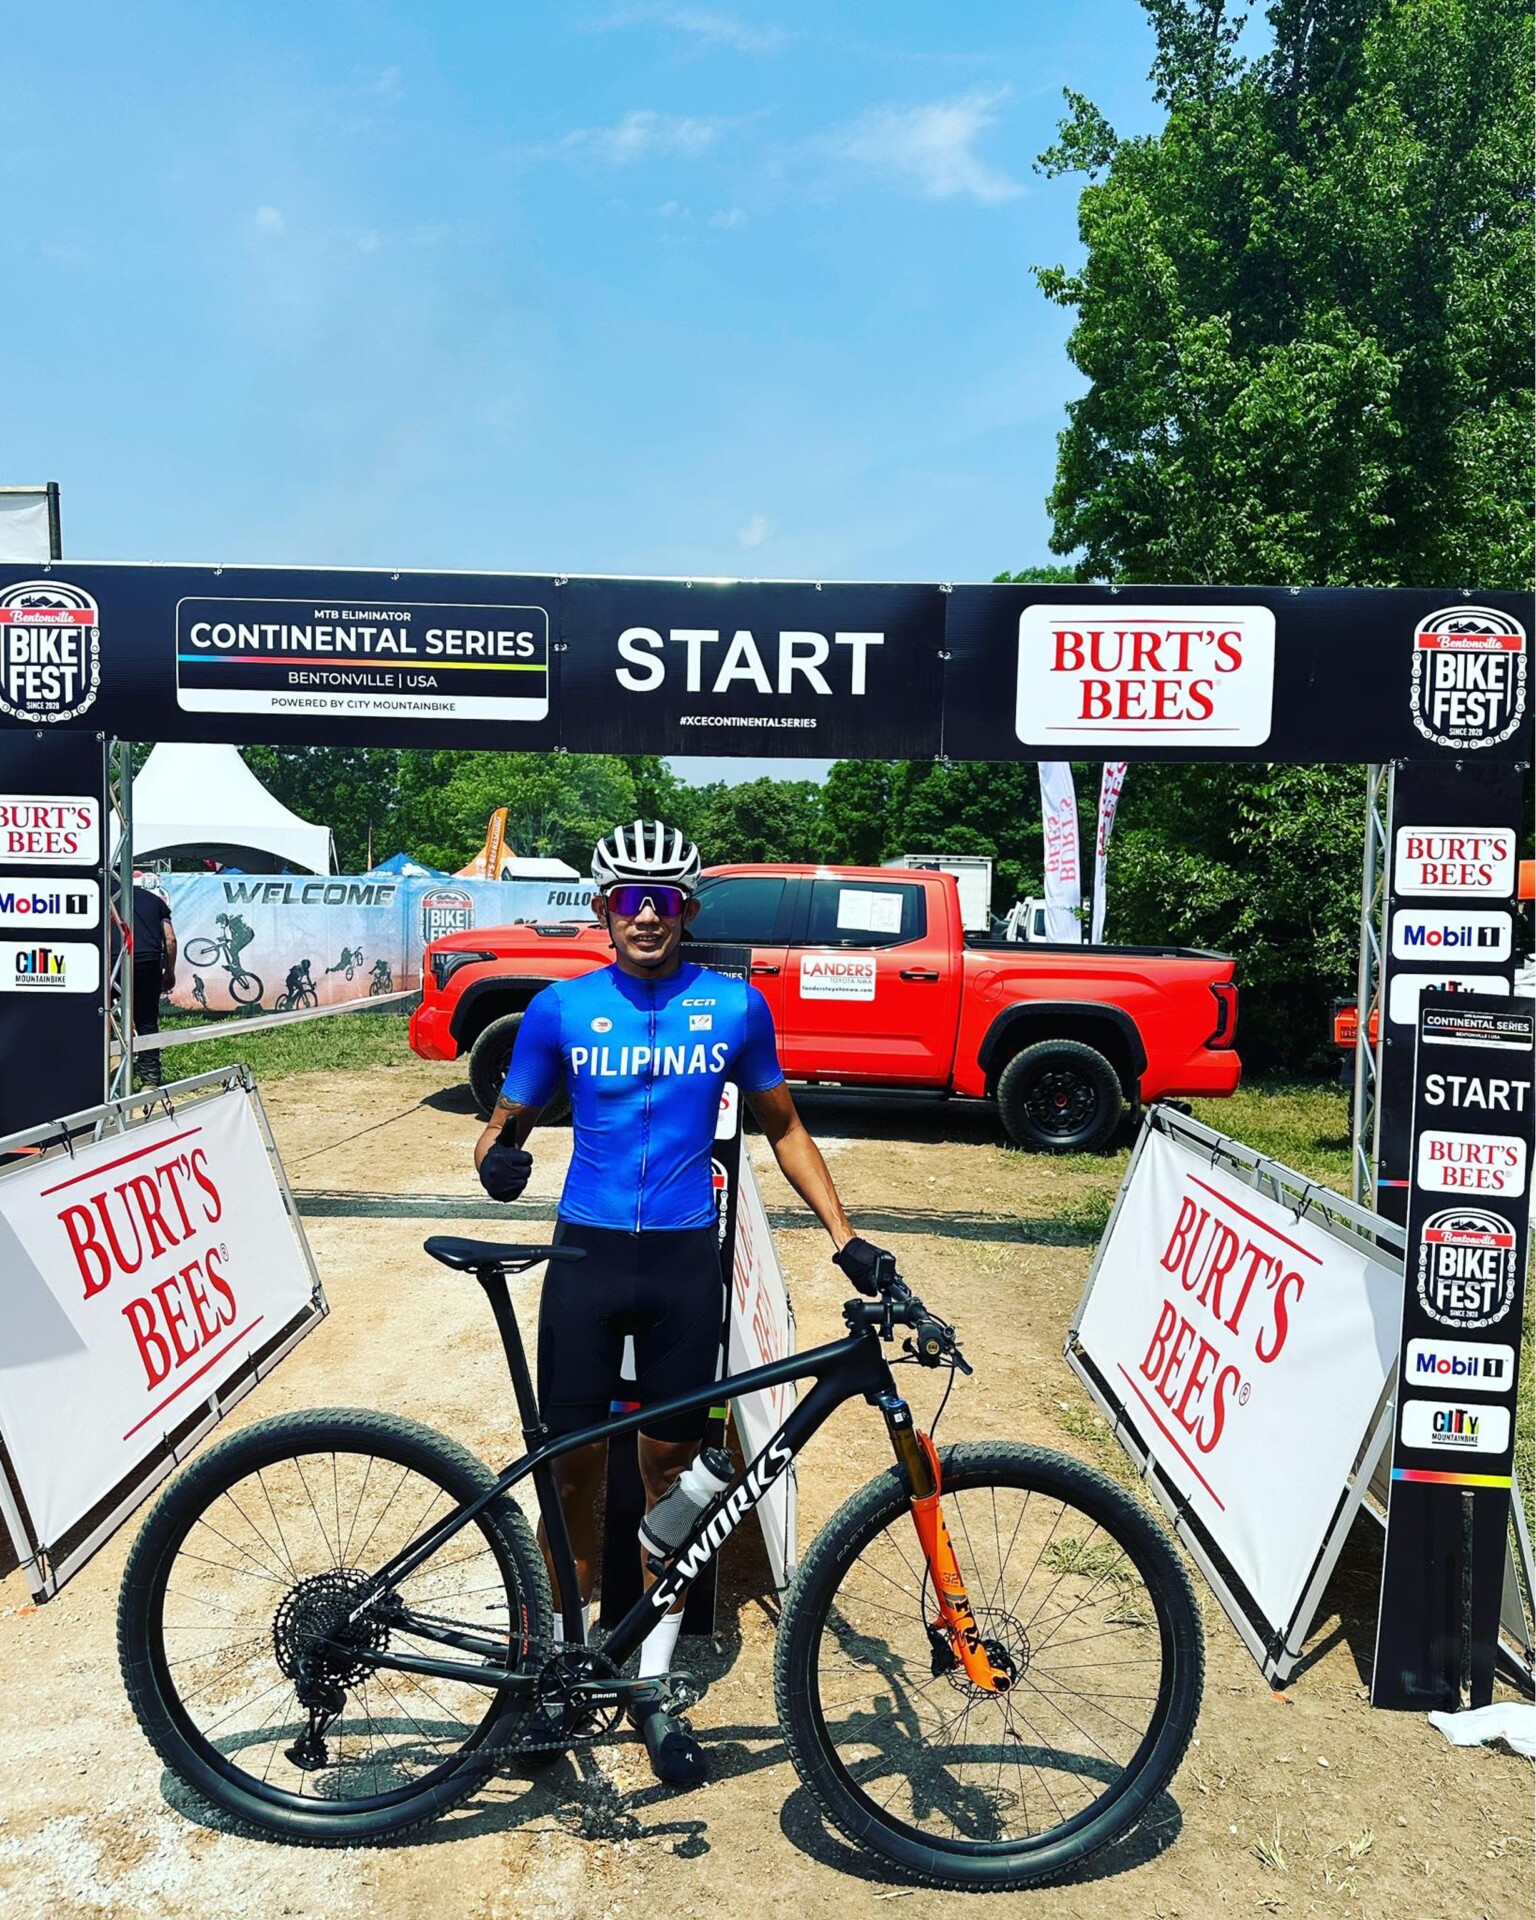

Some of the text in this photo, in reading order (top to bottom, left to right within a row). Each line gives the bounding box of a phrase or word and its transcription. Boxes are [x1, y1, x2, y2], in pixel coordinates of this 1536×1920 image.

[9, 610, 75, 623] Bentonville
[314, 610, 412, 621] MTB ELIMINATOR
[9, 628, 78, 664] BIKE
[190, 622, 534, 657] CONTINENTAL SERIES
[1437, 636, 1503, 649] Bentonville
[615, 627, 884, 695] START
[1050, 630, 1243, 673] BURT'S
[288, 672, 438, 688] BENTONVILLE USA
[1435, 653, 1505, 690] BIKE
[9, 665, 78, 703] FEST
[26, 701, 60, 710] SINCE 2020
[271, 698, 456, 711] POWERED BY CITY MOUNTAINBIKE
[1078, 679, 1215, 721] BEES
[1433, 691, 1504, 730] FEST
[680, 716, 817, 728] #XCECONTINENTALSERIES
[1449, 728, 1483, 736] SINCE 2020
[7, 831, 78, 854] BEES
[1405, 837, 1508, 862] BURT'S
[1420, 863, 1493, 886] BEES
[0, 893, 61, 914] Mobil
[222, 881, 396, 906] WELCOME
[547, 890, 598, 906] FOLLO
[431, 909, 465, 927] BIKE
[1404, 925, 1472, 946] Mobil
[15, 948, 66, 974] CITY
[803, 962, 873, 977] LANDERS
[15, 975, 66, 984] MOUNTAINBIKE
[1427, 1016, 1495, 1029] CONTINENTAL
[1496, 1021, 1530, 1032] SERIES
[571, 1041, 728, 1077] PILIPINAS
[1424, 1074, 1531, 1111] START
[1429, 1140, 1518, 1166] BURT'S
[1441, 1166, 1505, 1190] BEES
[57, 1148, 223, 1300] BURT'S
[1441, 1231, 1497, 1246] Bentonville
[1438, 1246, 1498, 1280] BIKE
[1159, 1195, 1305, 1363] BURT'S
[1436, 1278, 1496, 1313] FEST
[1450, 1309, 1465, 1317] SINCE
[1416, 1353, 1478, 1376] Mobil
[1432, 1408, 1480, 1434] CITY
[1432, 1433, 1479, 1444] MOUNTAINBIKE
[651, 1432, 793, 1617] S-WORKS
[943, 1572, 959, 1585] 32
[349, 1585, 386, 1623] EPIC
